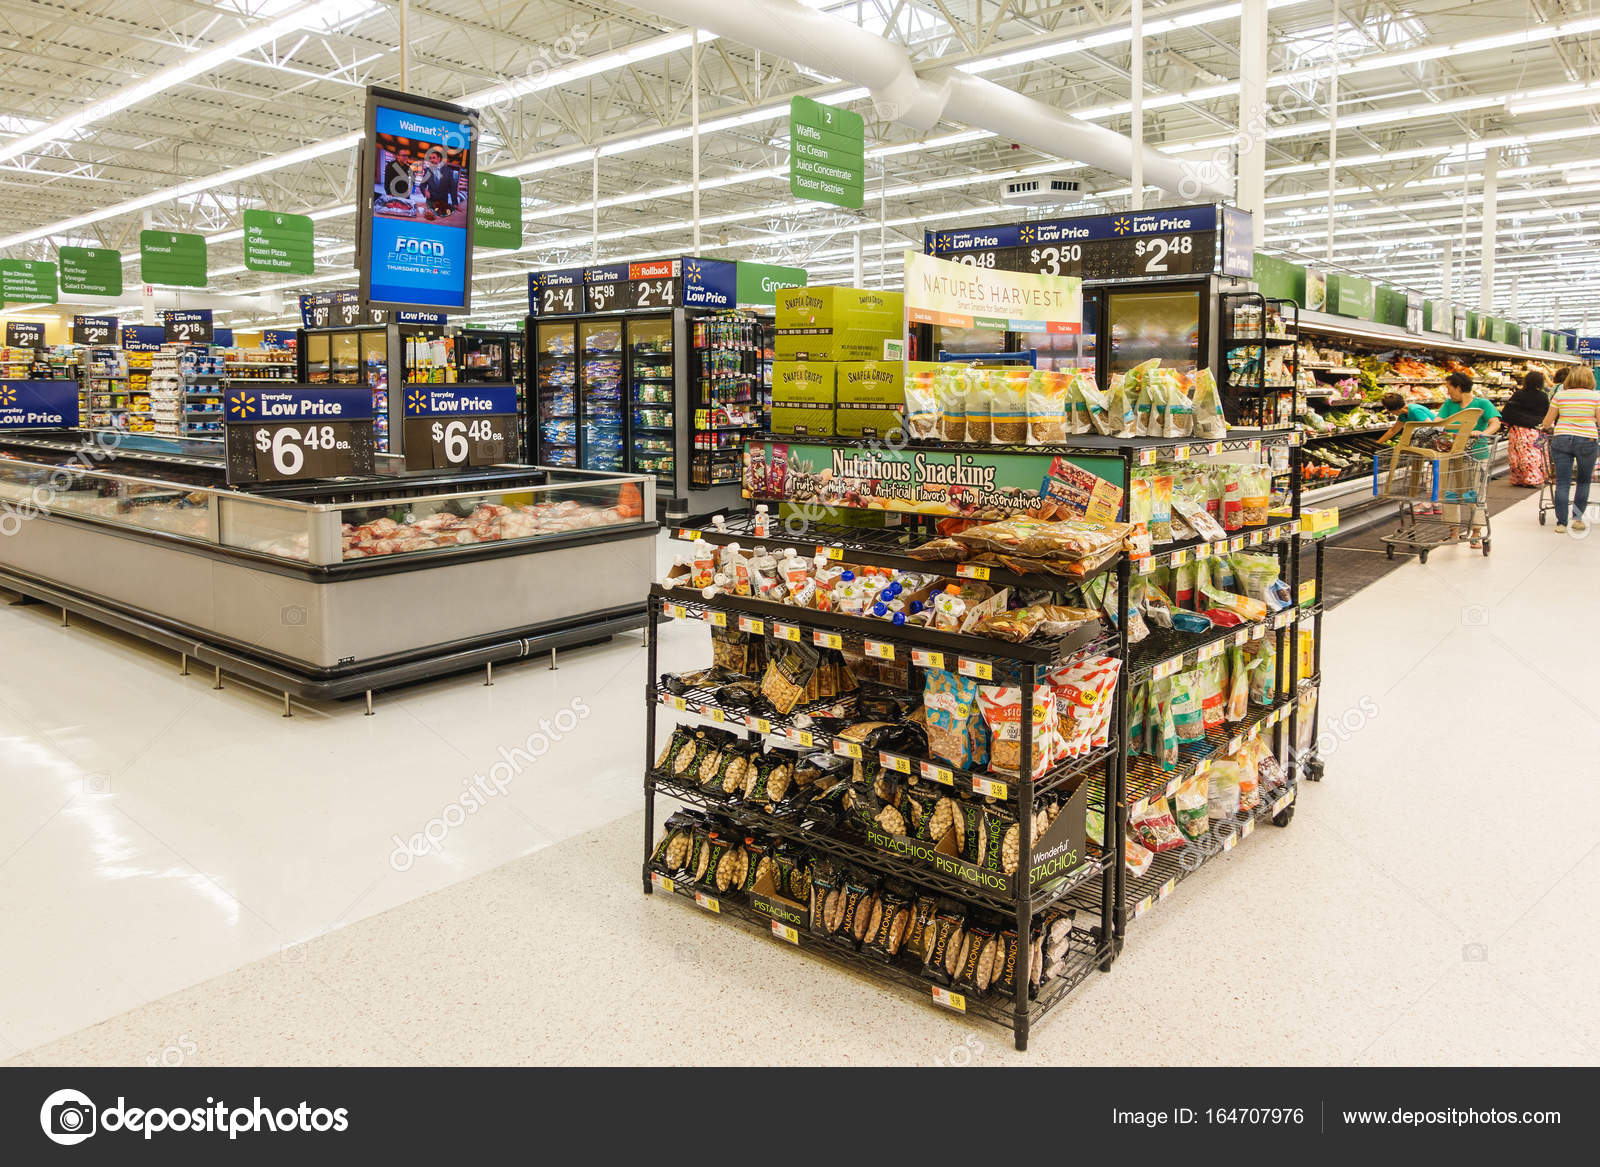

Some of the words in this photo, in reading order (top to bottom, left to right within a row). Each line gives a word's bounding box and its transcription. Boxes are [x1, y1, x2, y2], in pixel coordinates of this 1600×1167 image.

[825, 113, 832, 124] 2
[400, 120, 436, 136] Walmart
[796, 124, 820, 140] Waffles
[796, 142, 806, 152] Ice
[807, 144, 828, 158] Cream
[796, 160, 812, 172] Juice
[814, 163, 852, 180] Concentrate
[482, 179, 488, 187] 4
[796, 176, 820, 189] Toaster
[820, 181, 844, 194] Pastries
[476, 205, 494, 215] Meals
[249, 227, 262, 236] Jelly
[476, 218, 512, 230] Vegetables
[1134, 222, 1158, 232] Low
[1160, 218, 1190, 230] Price
[954, 238, 972, 248] Low
[974, 236, 998, 246] Price
[1038, 230, 1060, 240] Low
[1062, 228, 1089, 238] Price
[250, 247, 270, 255] Frozen
[396, 238, 444, 256] FOOD
[250, 258, 272, 266] Peanut
[273, 259, 292, 267] Butter
[388, 252, 451, 266] FIGHTERS
[592, 272, 604, 281] Low
[604, 272, 618, 280] Price
[642, 266, 668, 276] Rollback
[548, 277, 558, 285] Low
[544, 290, 554, 312] 2
[638, 282, 650, 306] 2
[687, 291, 705, 301] Low
[706, 292, 727, 304] Price
[785, 298, 804, 310] SNAPEA
[806, 296, 823, 309] CRISPS
[400, 312, 417, 320] Low
[418, 312, 438, 321] Price
[783, 370, 803, 384] SNAPEA
[804, 370, 822, 384] CRISPS
[848, 371, 870, 384] SNAPEA
[872, 369, 894, 384] CRISPS
[262, 402, 298, 416] Low
[300, 400, 342, 414] Price
[431, 398, 458, 412] Low
[460, 396, 492, 410] Price
[28, 413, 62, 424] Price
[832, 448, 911, 482] Nutritious
[914, 455, 995, 492] Snacking
[792, 477, 814, 491] Fruits
[828, 480, 846, 493] Nuts
[860, 483, 872, 496] No
[876, 484, 912, 500] Artificial
[917, 485, 946, 502] Flavors
[963, 490, 974, 504] No
[979, 491, 1042, 510] Preservatives
[1033, 710, 1046, 720] EW!
[868, 831, 934, 862] PISTACHIOS
[1034, 840, 1069, 864] Wonderful
[705, 846, 720, 884] PISTACHIOS
[936, 858, 1006, 891] PISTACHIOS
[754, 900, 801, 924] PISTACHIOS
[816, 888, 826, 928] ALMONDS
[844, 893, 858, 933] ALMONDS
[878, 904, 894, 946] ALMONDS
[934, 922, 950, 967] ALMONDS
[966, 936, 983, 980] ALMONDS
[1004, 940, 1018, 984] ALMONDS
